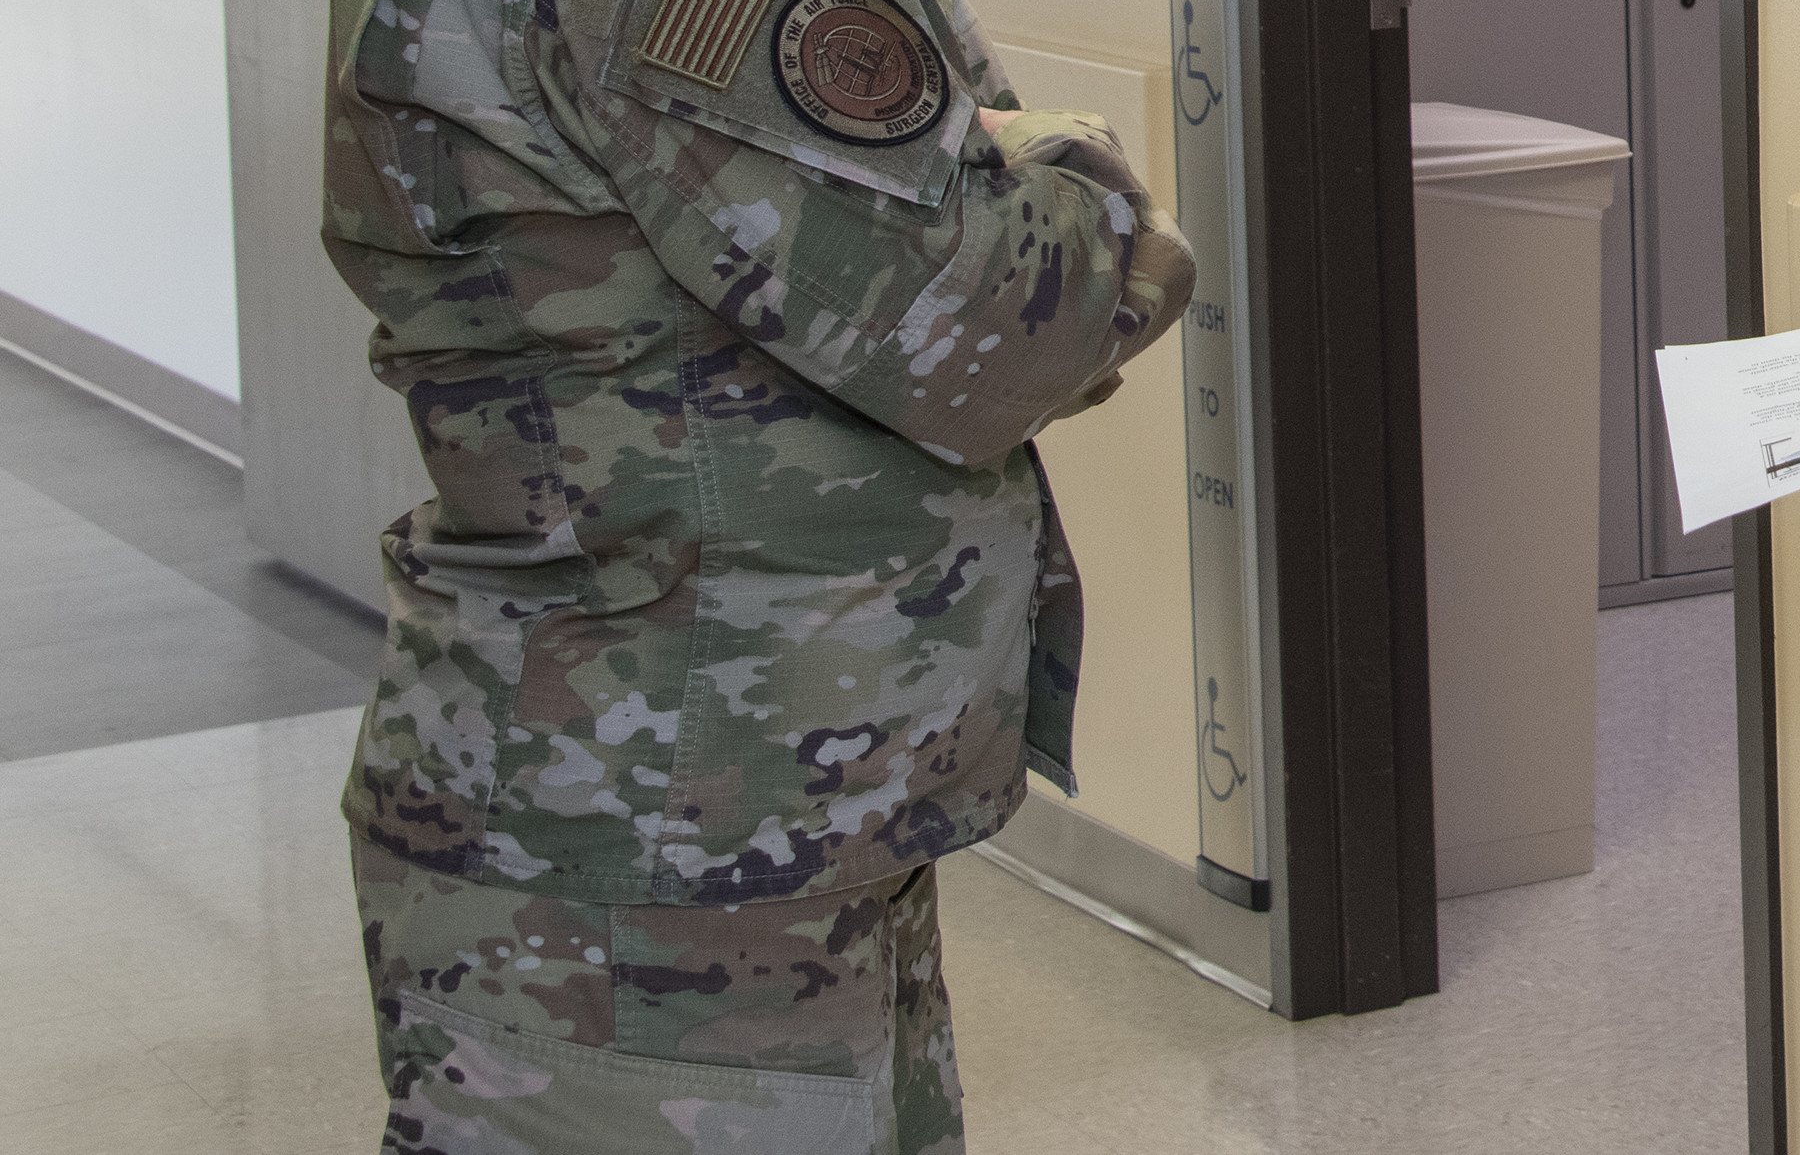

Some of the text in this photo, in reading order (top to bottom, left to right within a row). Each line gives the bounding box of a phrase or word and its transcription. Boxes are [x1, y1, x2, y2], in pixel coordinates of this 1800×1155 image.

[786, 18, 805, 43] THE
[785, 53, 798, 69] OF
[790, 78, 829, 120] OFFICE
[885, 42, 939, 135] SURGEON GENERAL
[1189, 299, 1226, 333] PUSH
[1199, 386, 1220, 418] TO
[1193, 471, 1235, 510] OPEN
